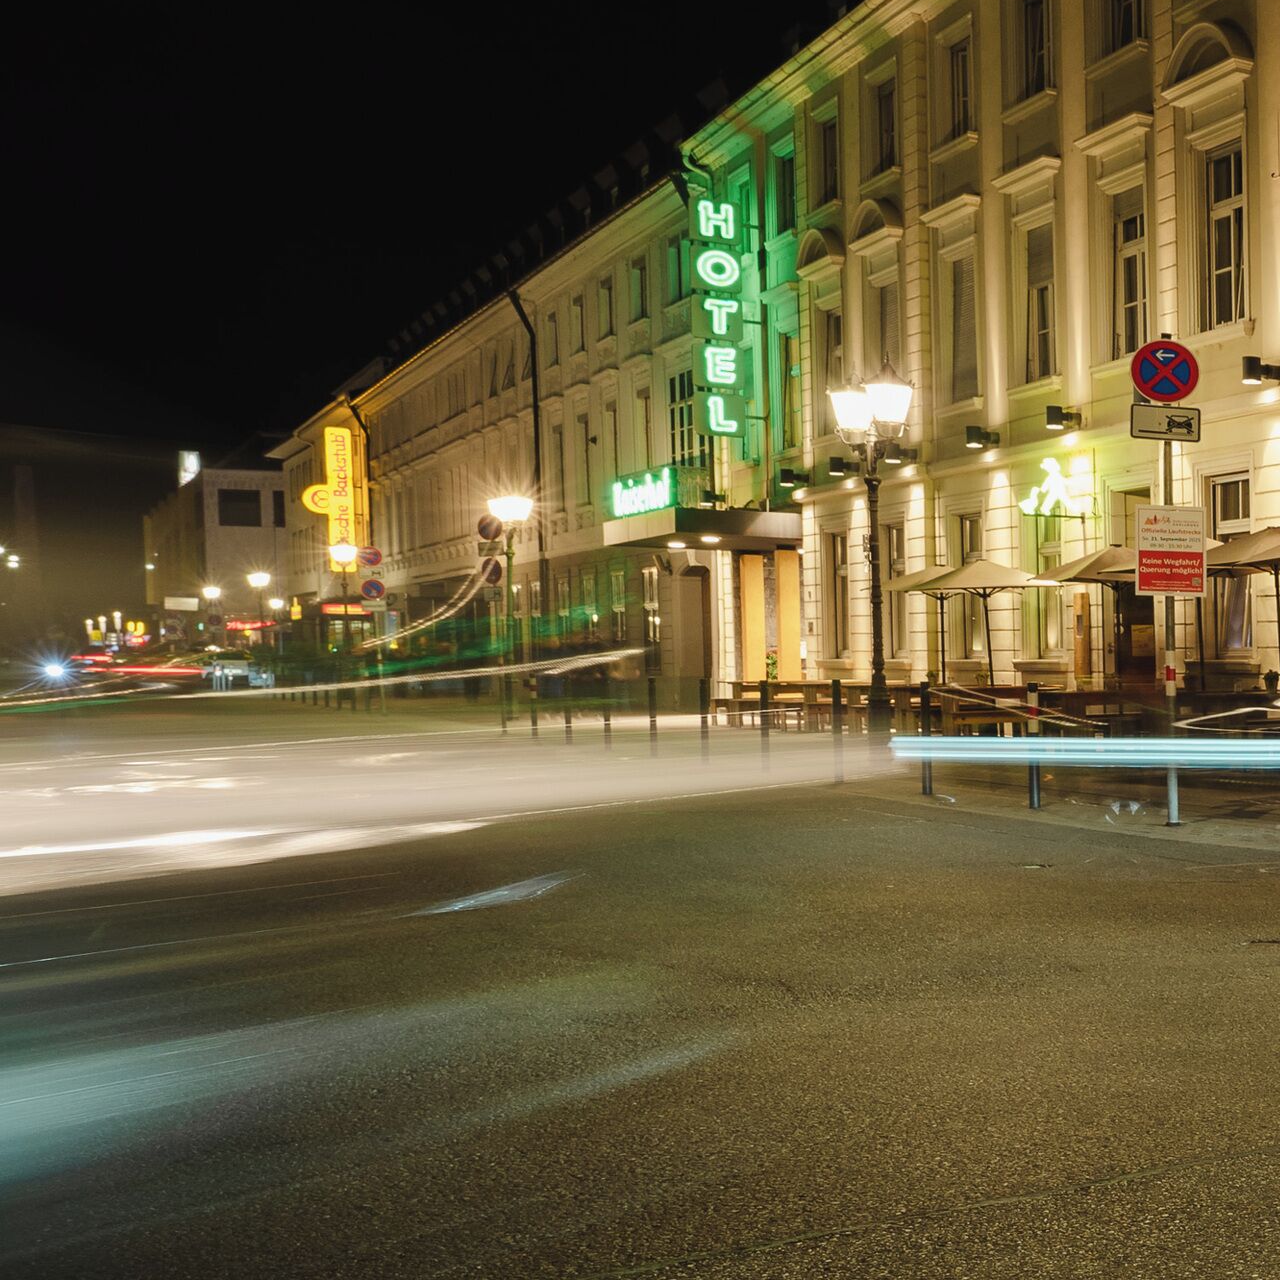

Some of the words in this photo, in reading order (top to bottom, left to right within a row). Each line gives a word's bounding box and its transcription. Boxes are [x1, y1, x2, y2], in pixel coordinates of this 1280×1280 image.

[697, 200, 740, 433] HOTEL
[1163, 558, 1201, 567] Wegfahrt/
[1139, 566, 1171, 575] Querung
[1172, 567, 1203, 575] möglich!
